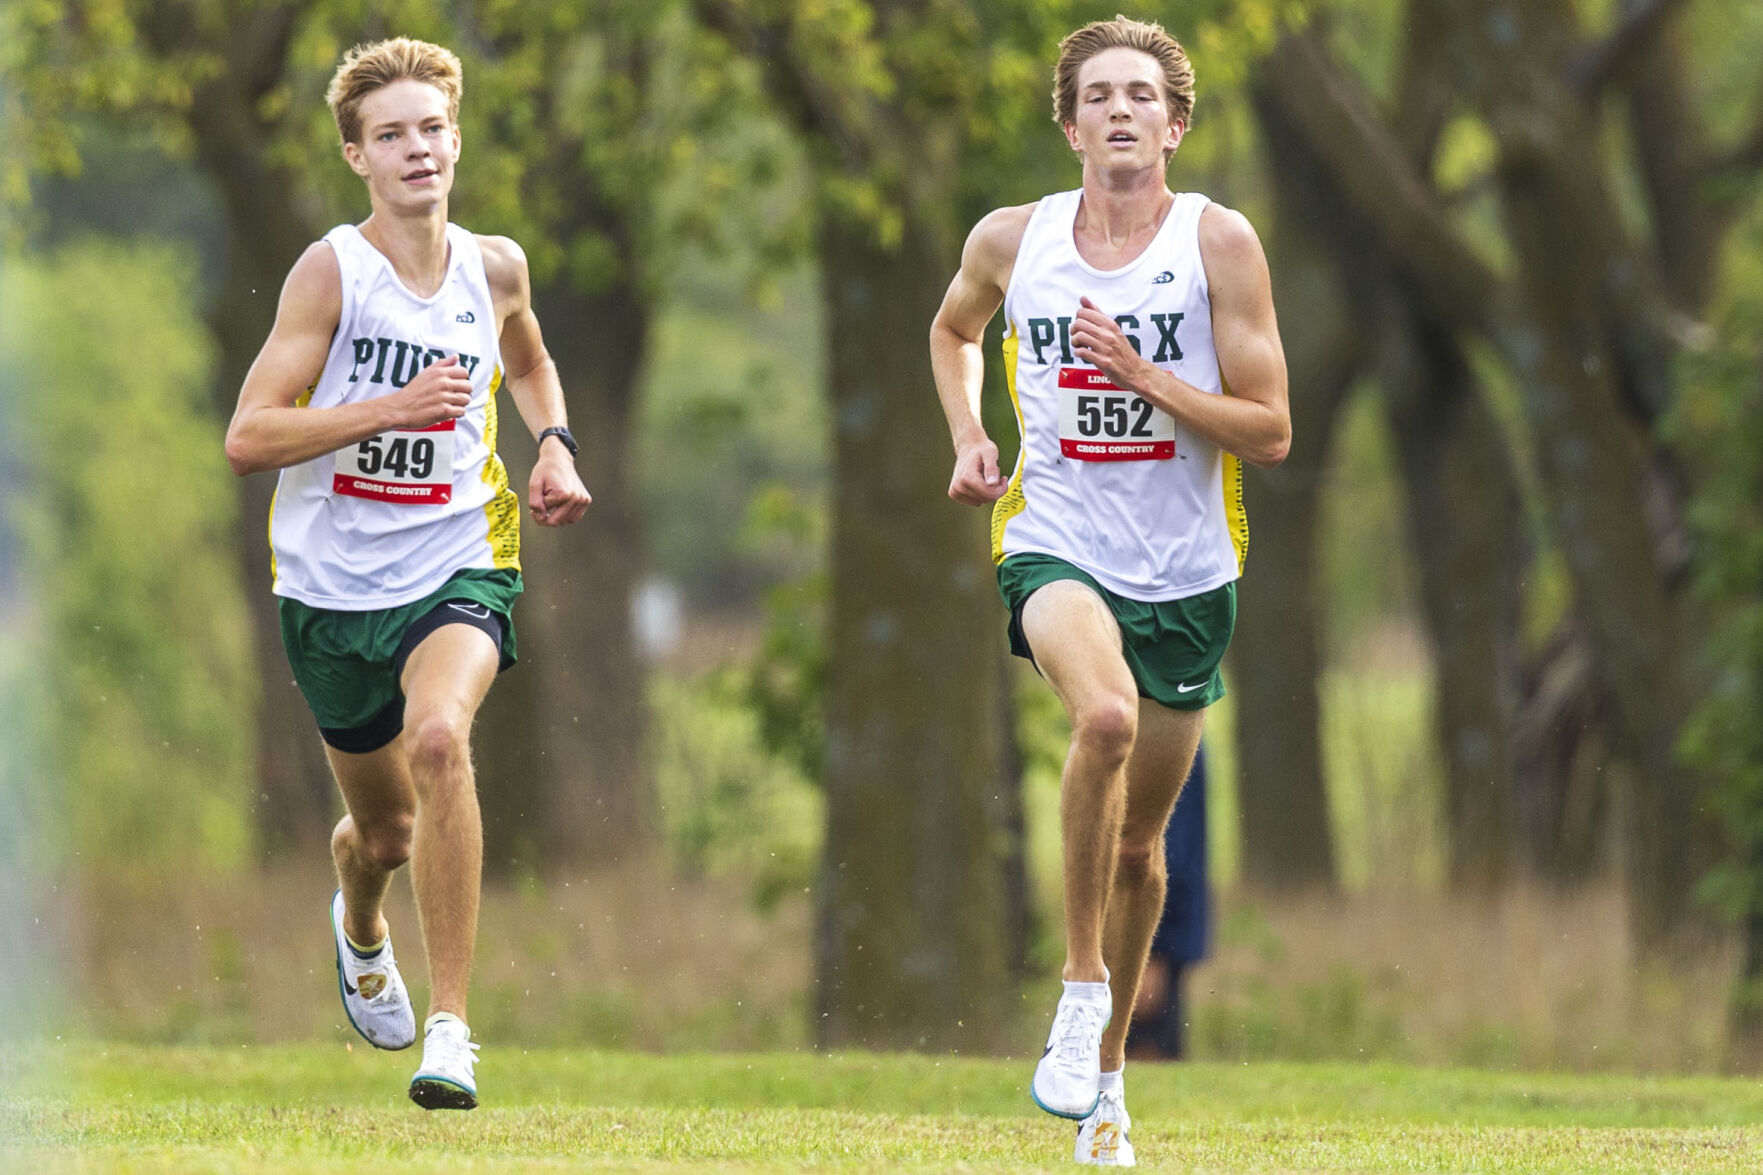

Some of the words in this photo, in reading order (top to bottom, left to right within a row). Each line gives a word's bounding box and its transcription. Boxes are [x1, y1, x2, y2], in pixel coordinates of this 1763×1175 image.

[1150, 312, 1184, 363] X
[1077, 396, 1154, 438] 552
[357, 435, 435, 479] 549
[1076, 444, 1106, 454] CROSS
[1108, 445, 1155, 454] COUNTRY
[353, 480, 384, 493] CROSS
[386, 486, 432, 496] COUNTRY
